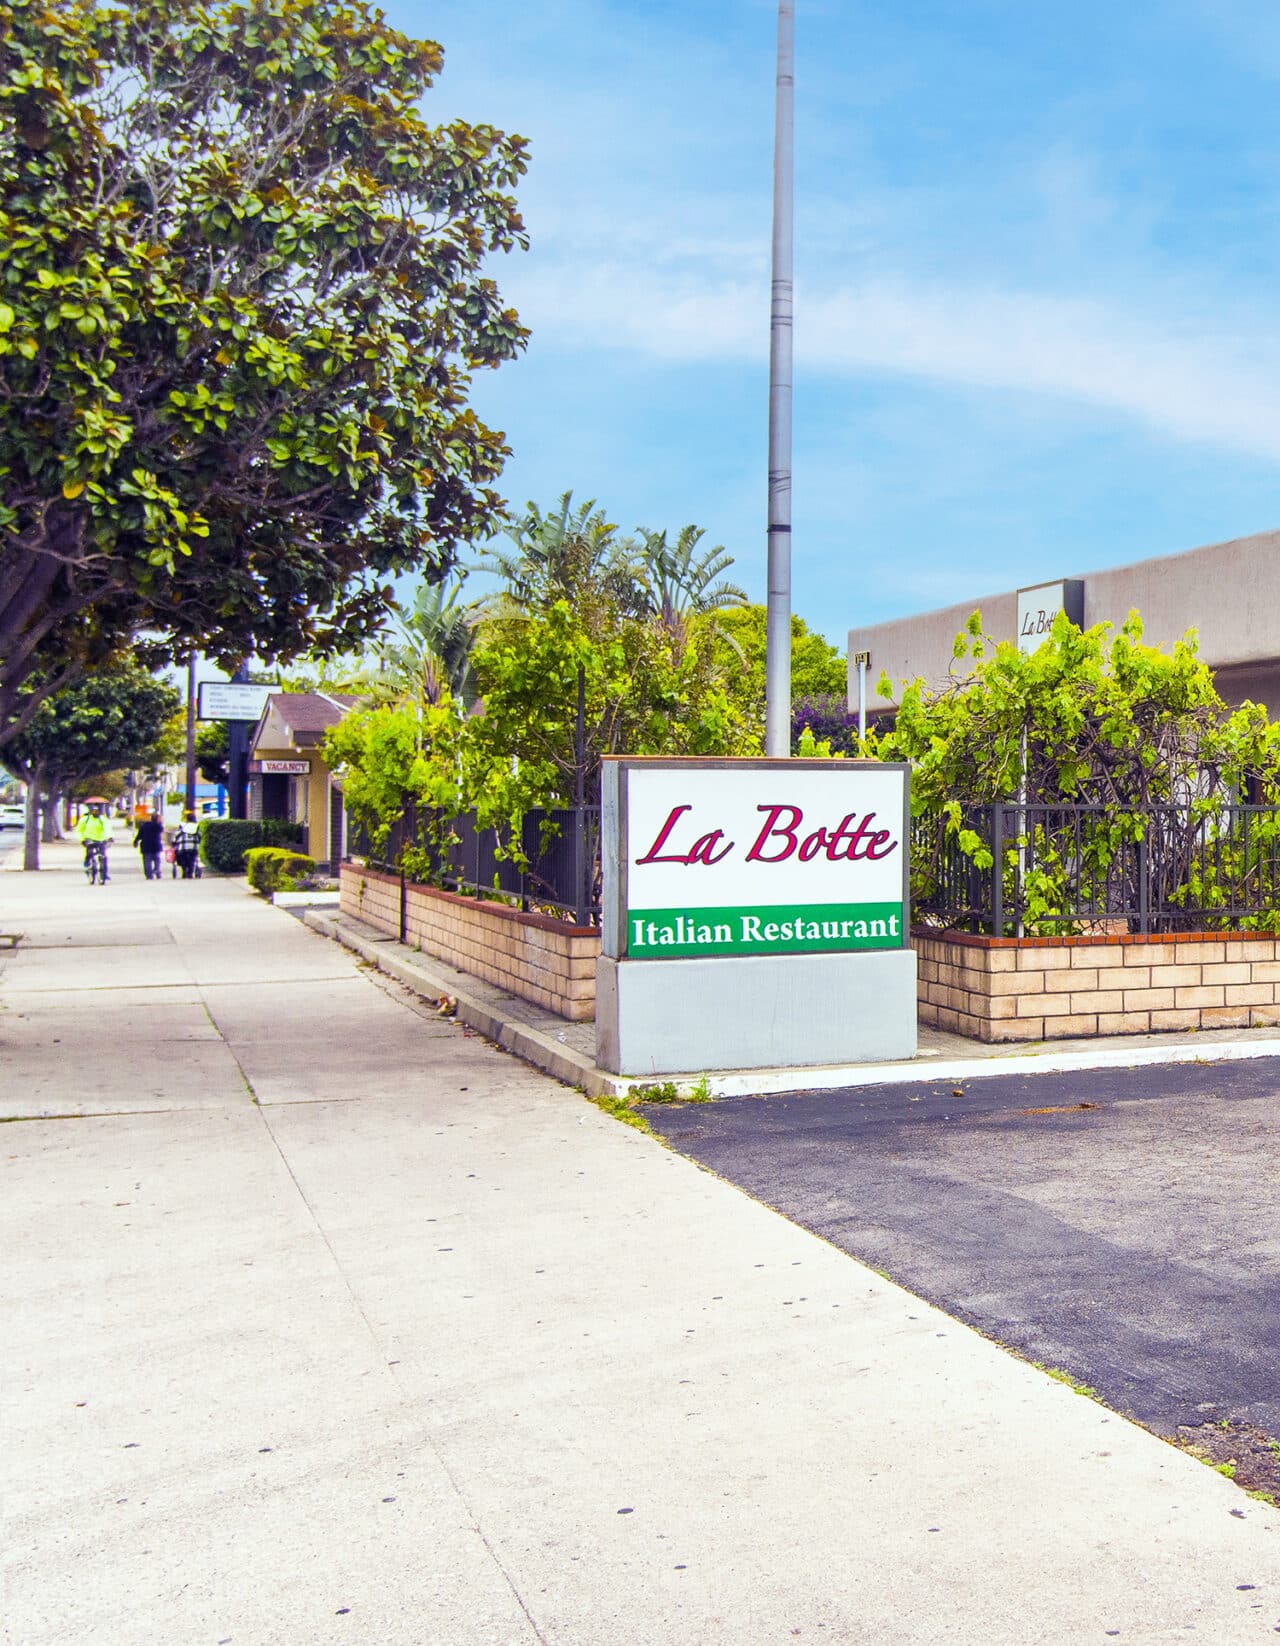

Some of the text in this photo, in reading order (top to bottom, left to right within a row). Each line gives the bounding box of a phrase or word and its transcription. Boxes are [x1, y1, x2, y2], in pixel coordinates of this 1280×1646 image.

[1020, 612, 1035, 636] La
[266, 762, 307, 772] VACANCY
[635, 804, 898, 866] La Botte
[632, 913, 899, 947] Italian Restaurant
